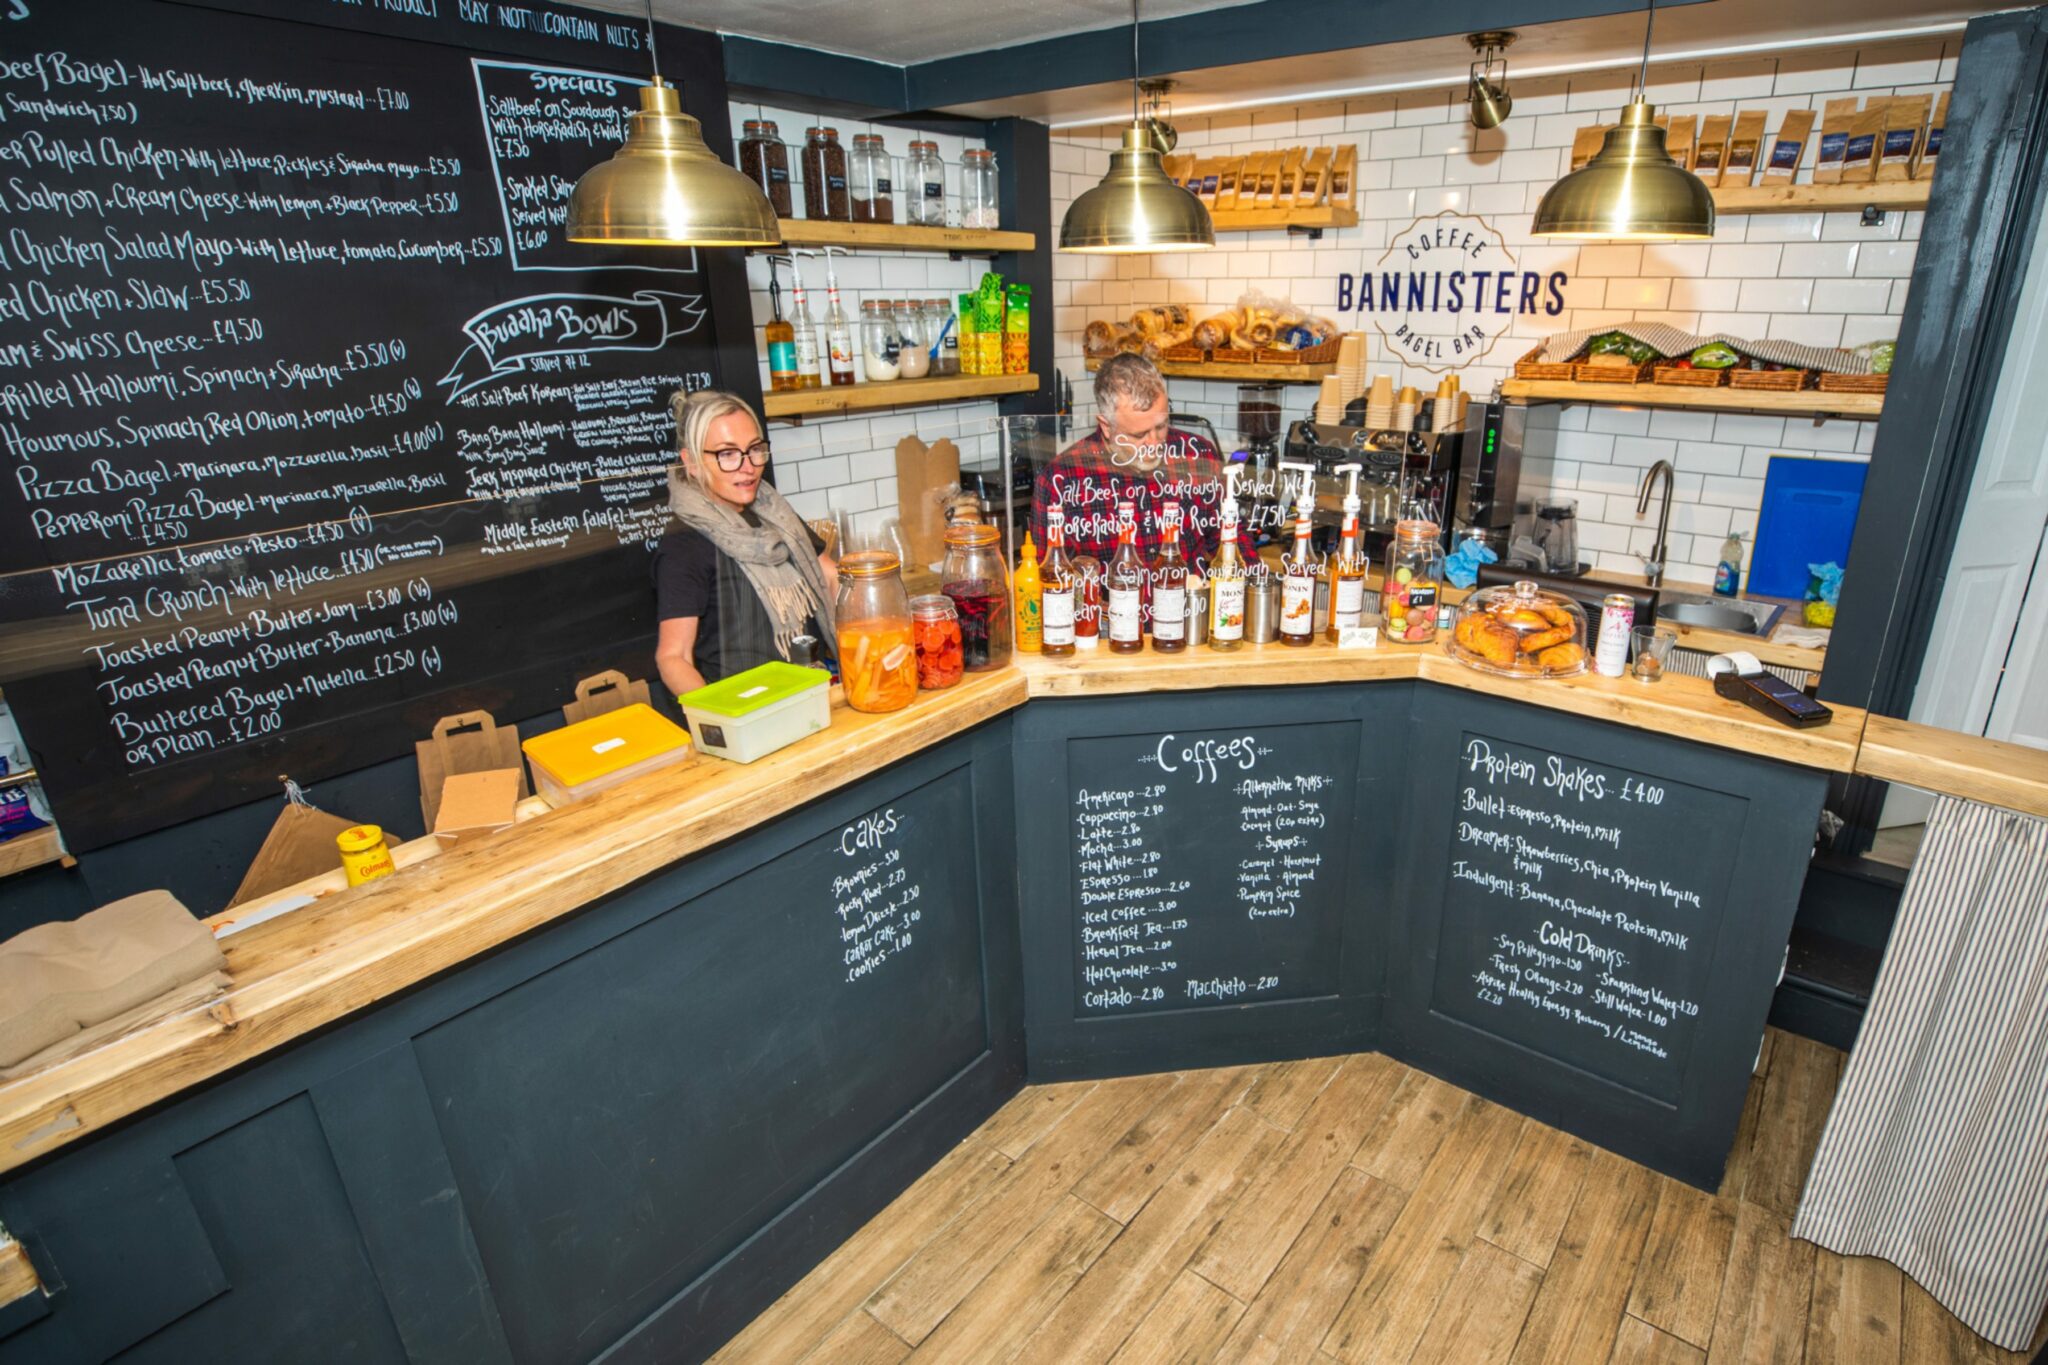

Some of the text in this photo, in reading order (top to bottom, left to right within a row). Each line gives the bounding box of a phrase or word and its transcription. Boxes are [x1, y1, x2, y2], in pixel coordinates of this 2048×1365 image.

[500, 5, 638, 50] NOT CONTAIN NUTS
[48, 52, 128, 92] Bagel
[7, 93, 100, 124] Sandwich
[544, 103, 561, 118] on
[491, 116, 623, 140] With Wild
[23, 131, 96, 173] Pulled
[100, 137, 179, 179] Chicken
[9, 177, 104, 217] Salmon
[332, 194, 373, 217] Black
[507, 177, 548, 201] Smoked
[512, 206, 546, 227] Served
[10, 228, 112, 276] Chicken
[106, 226, 173, 259] Salad
[175, 230, 233, 272] Mayo
[516, 231, 548, 252] £6.00
[1406, 228, 1487, 260] COFFEE
[28, 281, 121, 327] Chicken
[127, 278, 189, 311] Slaw
[1337, 270, 1568, 316] BANNISTERS
[43, 328, 123, 361] Swiss
[125, 330, 204, 369] Cheese
[476, 305, 638, 355] Buddha Bowls
[1395, 323, 1486, 358] BAGEL BAR
[183, 364, 268, 400] Spinach
[204, 411, 244, 437] Red
[302, 406, 365, 431] tomato
[16, 459, 174, 501] Pizza Bagel
[549, 458, 592, 479] Chicken
[127, 495, 194, 527] Pizza
[187, 488, 254, 522] Bagel
[1126, 485, 1147, 508] on
[180, 533, 298, 569] tomato Pesto
[483, 519, 529, 546] Middle
[66, 599, 141, 631] Tuna
[274, 564, 335, 592] lettuce
[83, 633, 180, 671] Toasted
[185, 621, 251, 655] Peanut
[249, 603, 314, 637] Butter
[318, 599, 357, 626] Jam
[97, 667, 191, 705] Toasted
[192, 653, 259, 688] Peanut
[260, 637, 323, 671] Butter
[331, 624, 396, 653] Banana
[110, 704, 224, 746] Buttered
[225, 680, 297, 714] Bagel
[154, 727, 218, 761] Plain
[1157, 734, 1255, 783] Coffees
[1543, 756, 1665, 805] Shakes £4.00
[842, 809, 896, 856] Cakes
[1660, 881, 1701, 909] Vanilla
[1539, 921, 1573, 952] Cold
[1187, 976, 1246, 999] Macchiato
